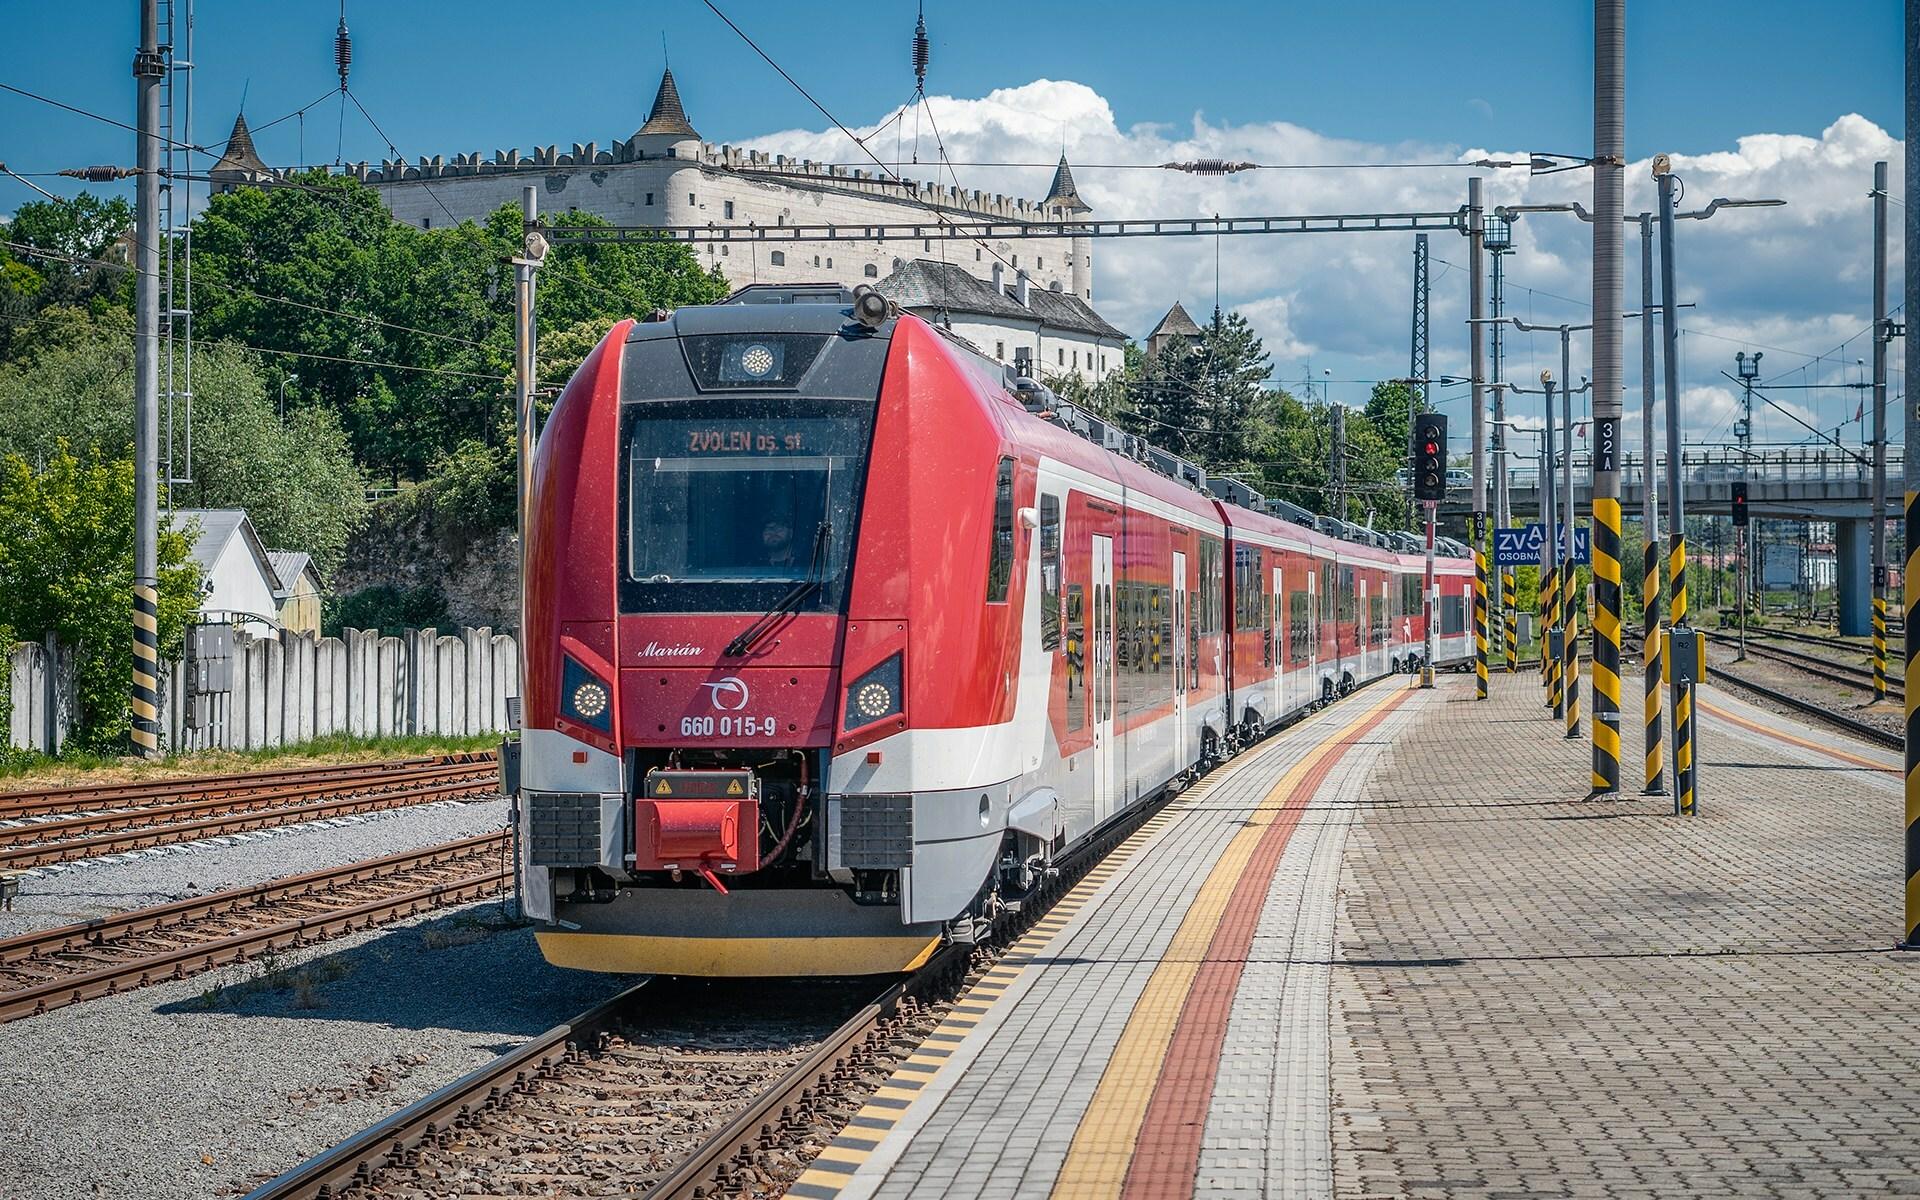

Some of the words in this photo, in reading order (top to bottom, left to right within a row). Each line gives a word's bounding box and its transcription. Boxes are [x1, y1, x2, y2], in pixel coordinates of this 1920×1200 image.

[689, 431, 751, 451] ZVOLEN
[1498, 533, 1585, 550] ZVN
[1498, 551, 1541, 561] OSOBNÁ
[637, 641, 705, 658] Marián
[681, 716, 714, 737] 660
[720, 716, 776, 737] 015-9
